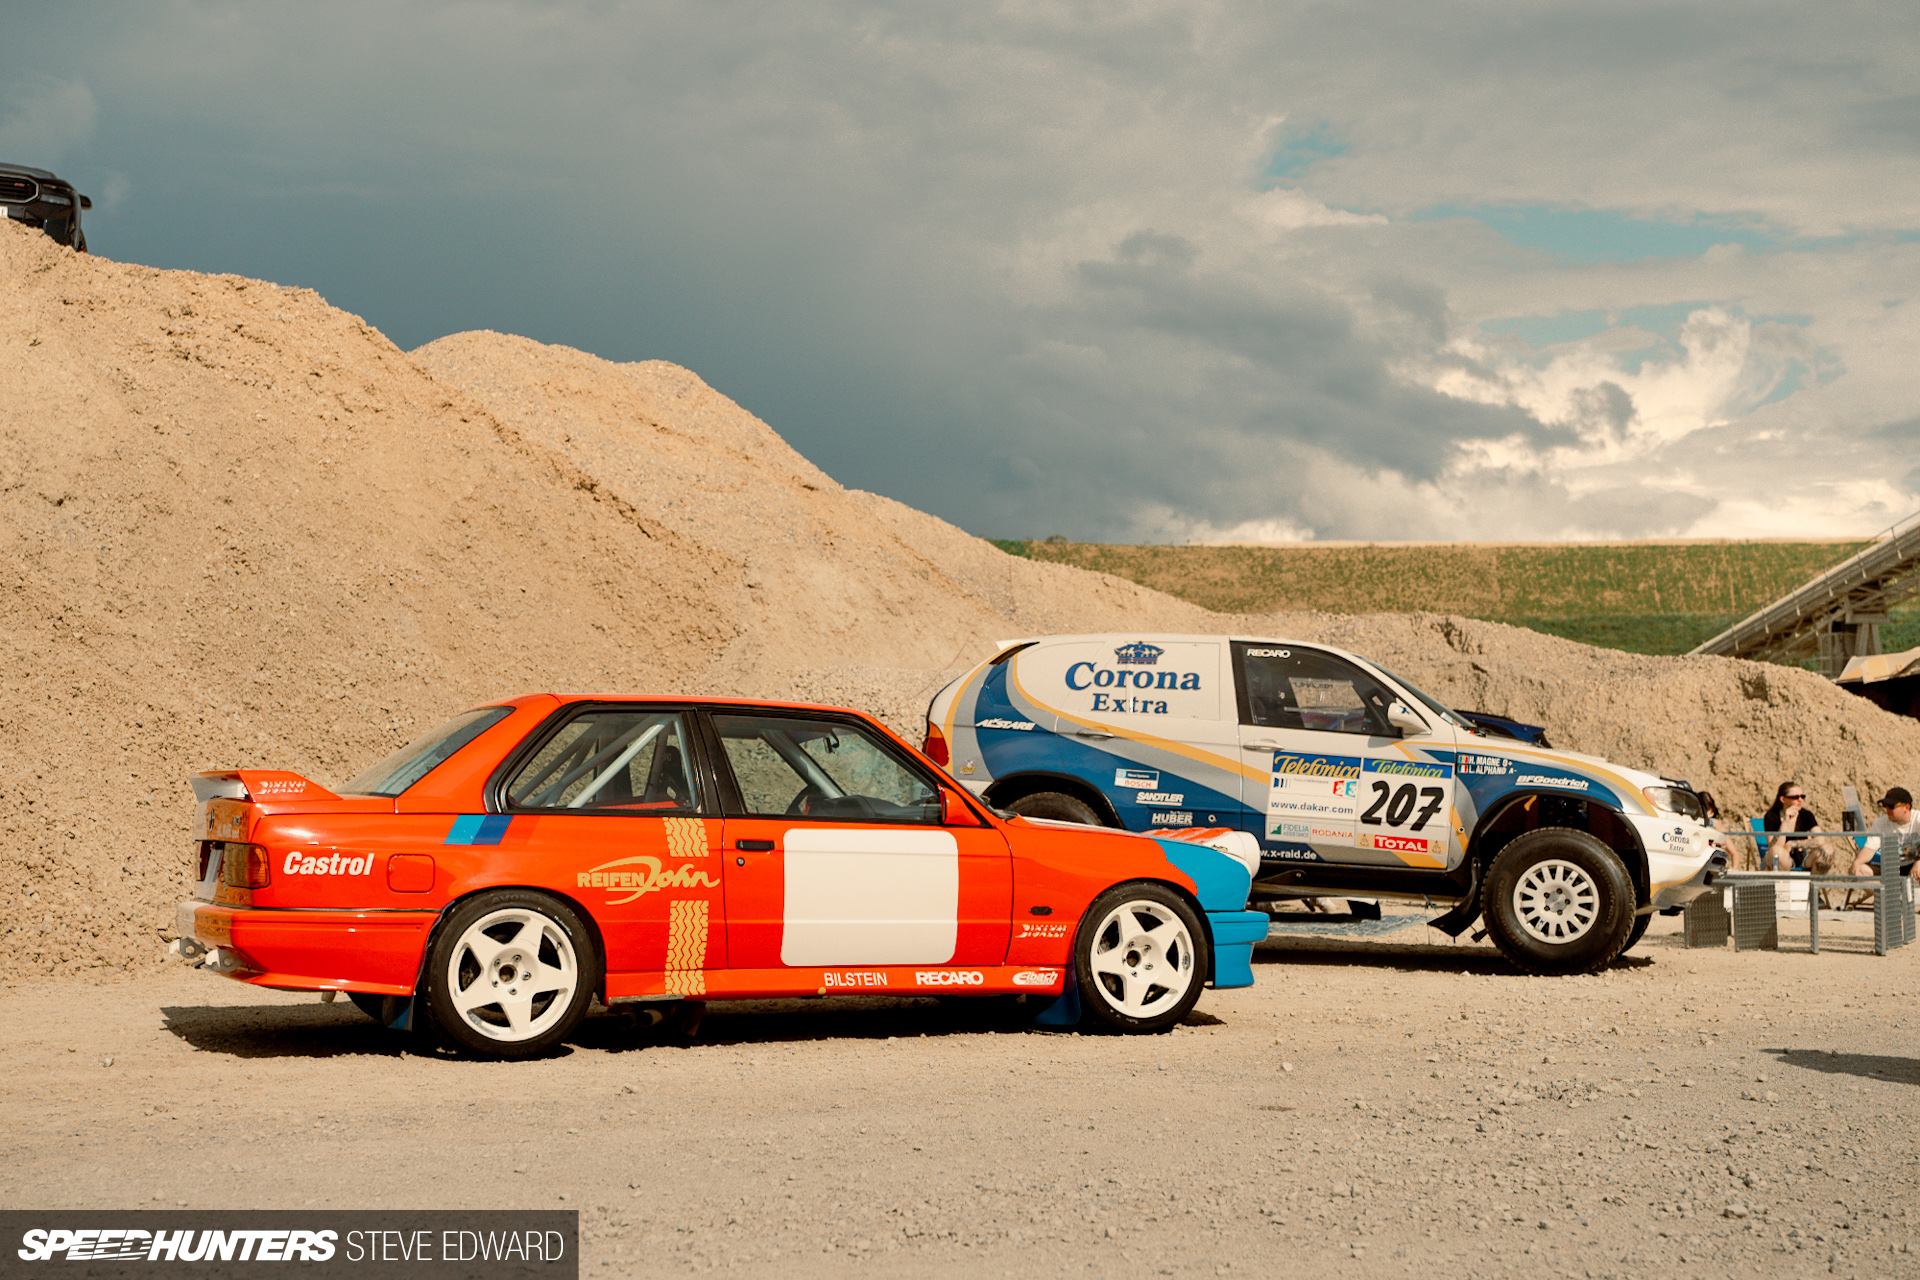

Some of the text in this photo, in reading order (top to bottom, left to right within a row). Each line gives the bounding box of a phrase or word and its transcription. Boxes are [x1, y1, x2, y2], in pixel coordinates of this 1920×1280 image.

[1247, 648, 1291, 659] RECARO
[1065, 661, 1201, 691] Corona
[1091, 693, 1168, 714] Extra
[1469, 756, 1476, 765] H.
[1476, 756, 1501, 767] MAGNE
[1475, 765, 1507, 775] ALPHAND
[1124, 779, 1152, 788] BOSCH
[1516, 775, 1590, 788] BFGoodrich
[1136, 791, 1184, 803] SANDTLER
[1271, 801, 1354, 815] www.dakar.com
[1360, 780, 1445, 832] 207
[1151, 812, 1193, 825] HUBER
[1283, 823, 1309, 832] FIDELIA
[1311, 828, 1354, 838] RODANIA
[1375, 835, 1427, 851] TOTAL
[1662, 832, 1690, 844] Corona
[283, 851, 375, 876] Castrol
[577, 872, 645, 888] REIFEN
[823, 972, 888, 986] BILSTEIN
[915, 971, 984, 985] RECARO
[1012, 971, 1058, 986] Eibach
